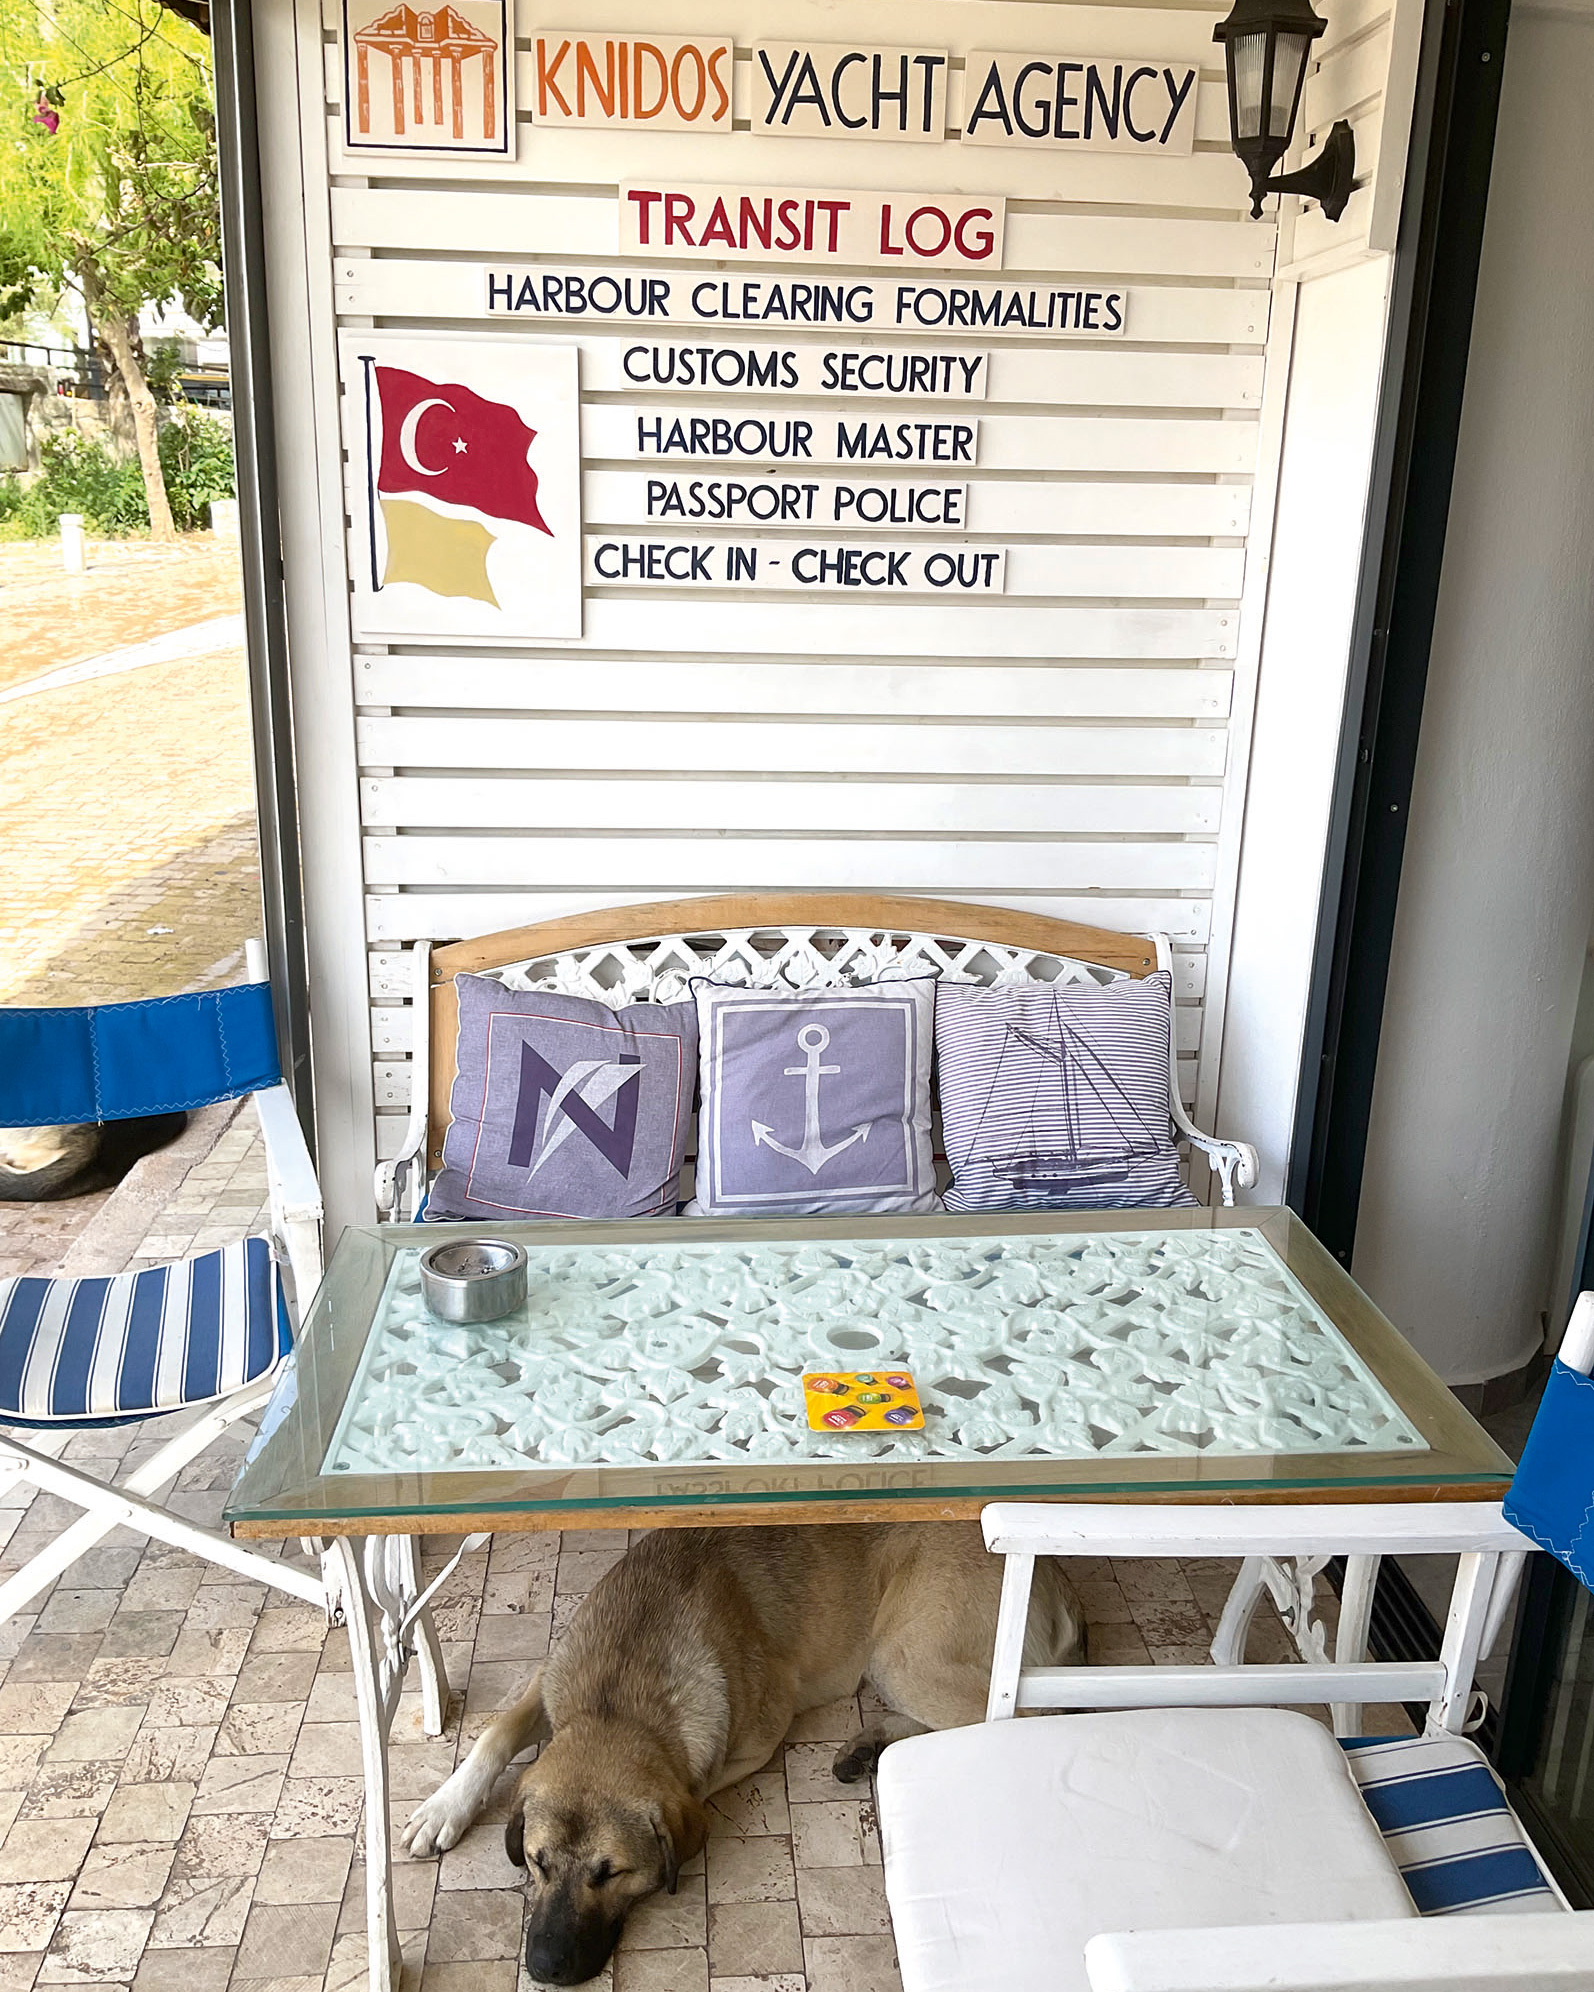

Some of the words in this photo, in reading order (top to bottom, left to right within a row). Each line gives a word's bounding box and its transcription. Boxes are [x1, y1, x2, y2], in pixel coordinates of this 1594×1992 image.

[537, 39, 728, 122] KNIDOS
[758, 50, 946, 132] YACHT
[967, 61, 1195, 144] AGENCY
[628, 190, 851, 253] TRANSIT
[881, 205, 994, 259] LOG
[488, 274, 670, 317] HARBOUR
[692, 282, 873, 322] CLEARING
[896, 287, 1121, 330] FORMALITIES
[624, 346, 798, 388] CUSTOMS
[821, 353, 982, 393] SECURITY
[638, 417, 812, 457] HARBOUR
[837, 423, 973, 460] MASTER
[648, 481, 819, 520] PASSPORT
[834, 486, 963, 524] POLICE
[595, 544, 715, 580] CHECK
[727, 547, 757, 580] IN
[792, 548, 911, 586] CHECK
[924, 553, 999, 587] OUT
